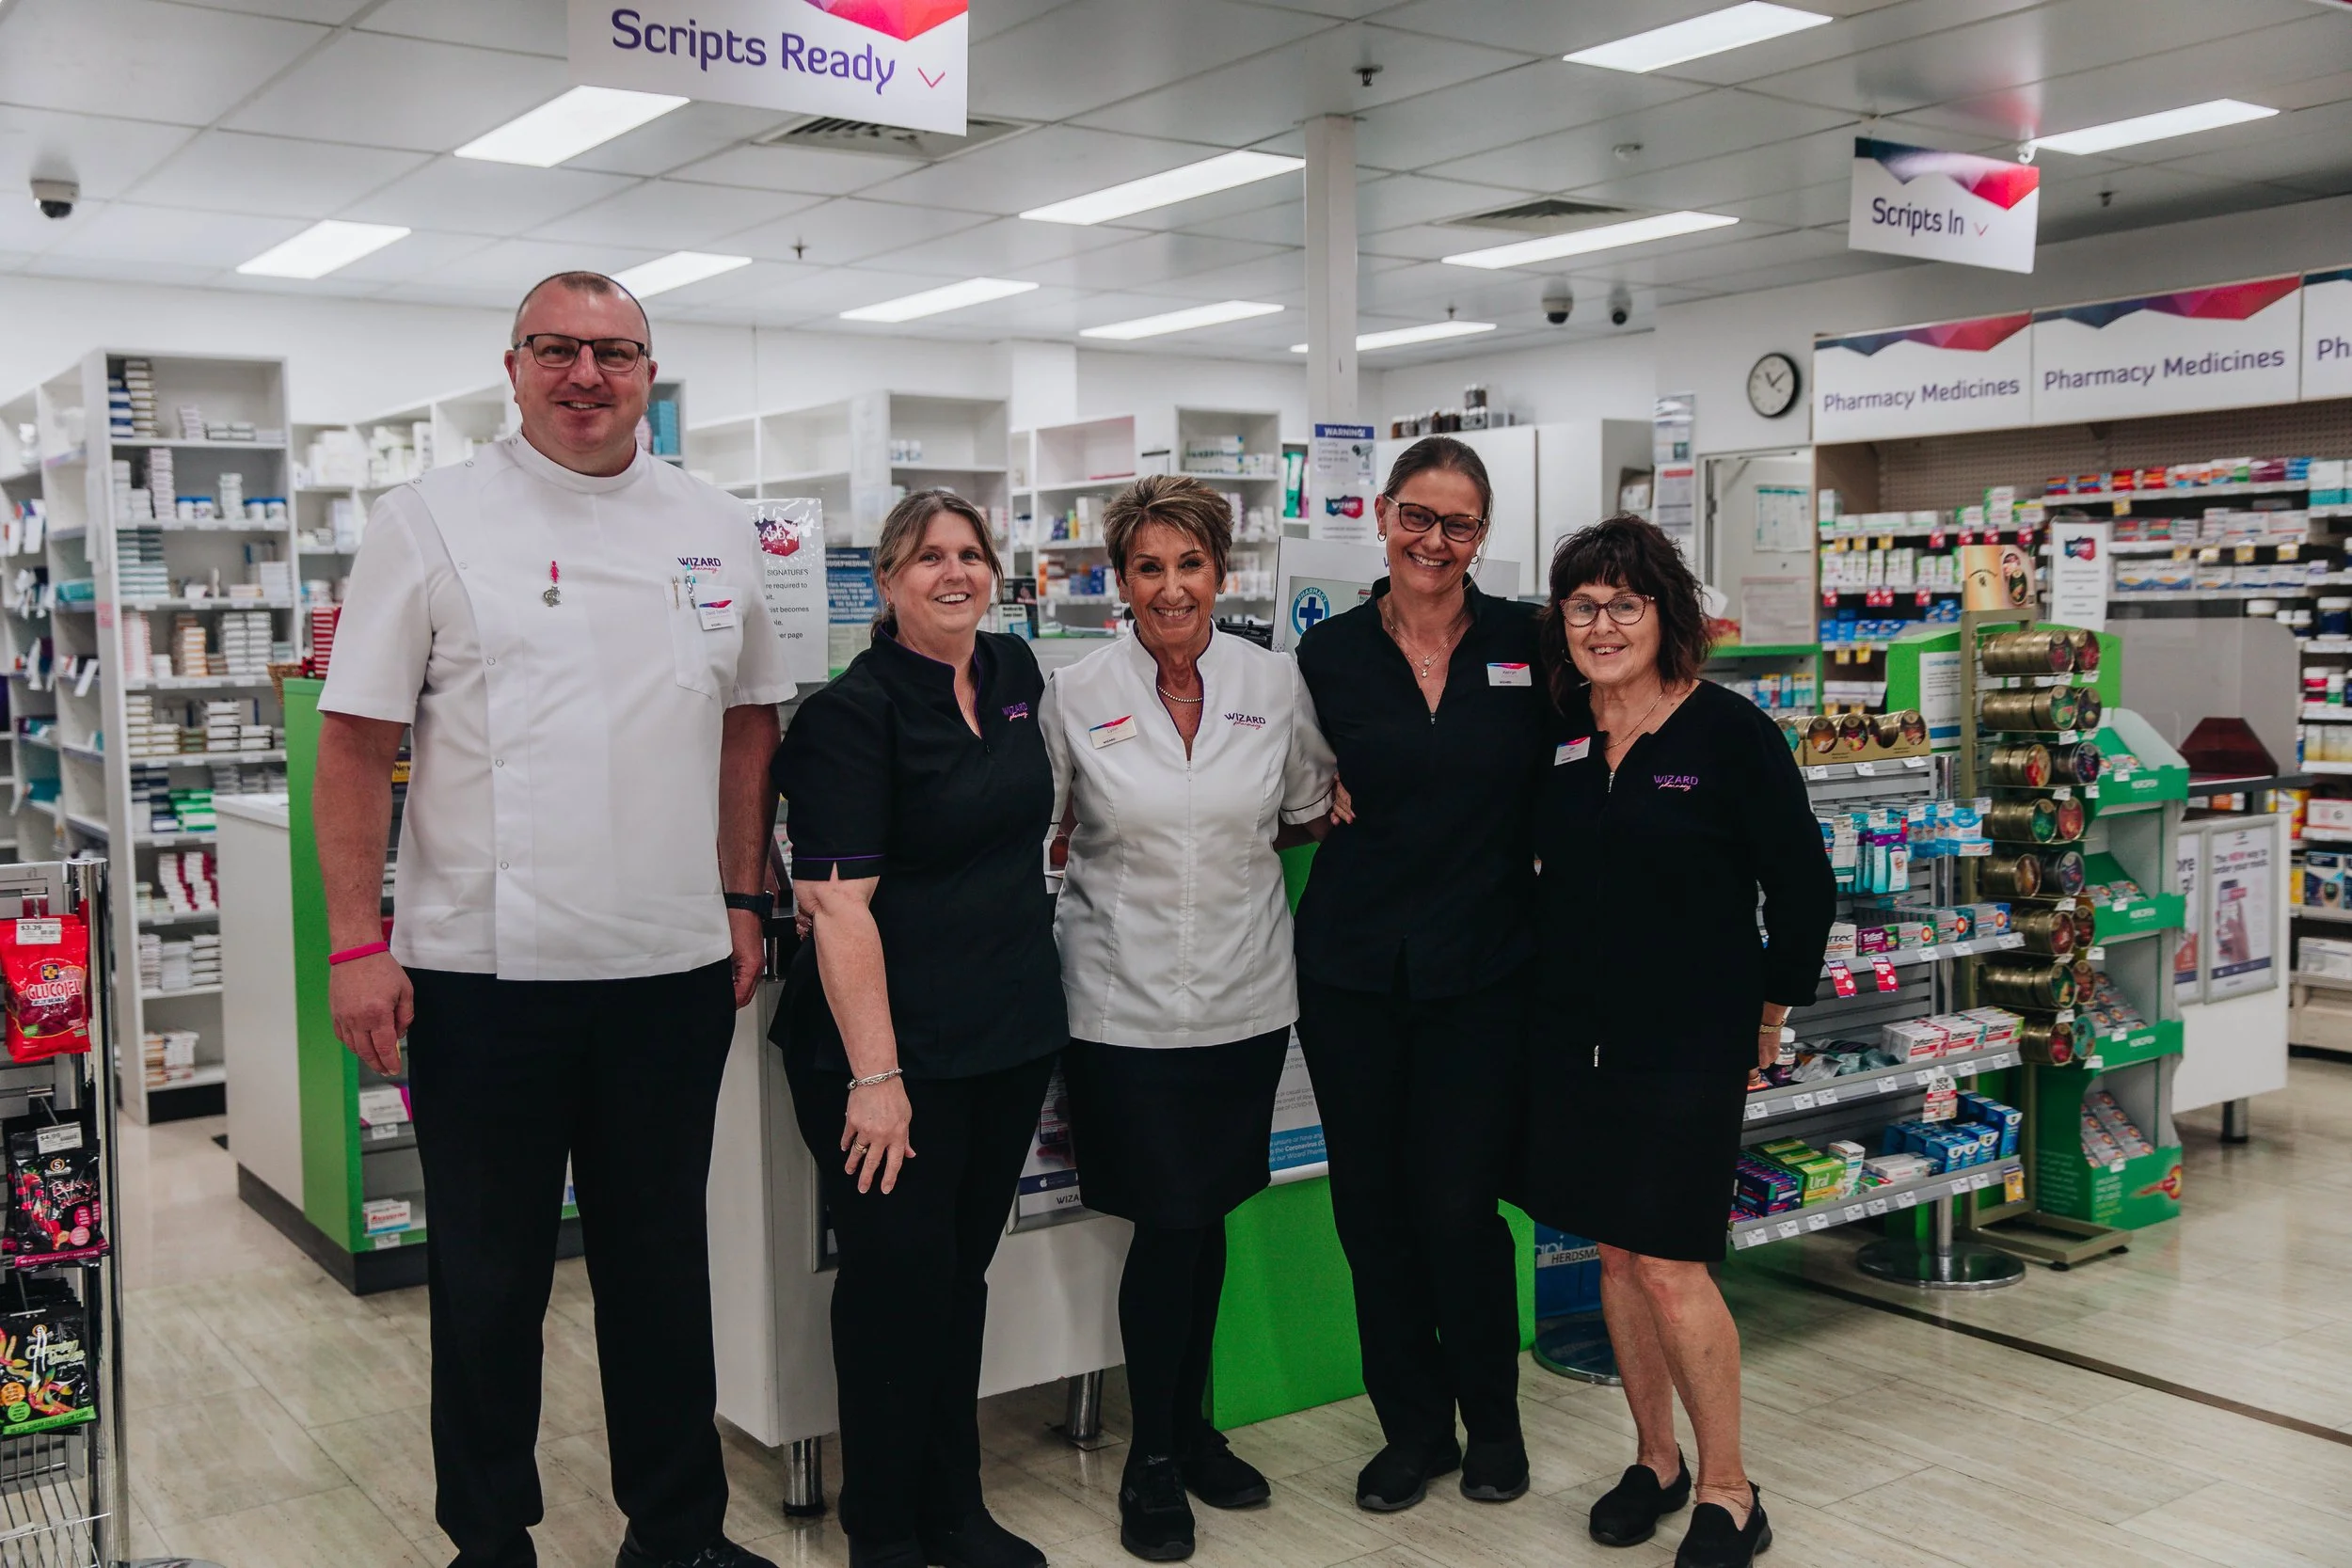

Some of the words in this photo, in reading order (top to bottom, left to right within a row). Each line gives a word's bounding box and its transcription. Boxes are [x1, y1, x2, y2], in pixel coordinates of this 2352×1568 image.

[612, 8, 767, 71] Scripts
[781, 32, 896, 94] Ready
[1872, 198, 1942, 236] Scripts
[1947, 207, 1964, 236] In
[2045, 361, 2155, 390] Pharmacy
[2164, 349, 2285, 377] Medicines
[1824, 388, 1915, 412] Pharmacy
[1921, 377, 2020, 403] Medicines
[1324, 426, 1366, 437] WARNING!
[677, 557, 722, 566] WIZARD
[773, 582, 800, 591] required
[1297, 587, 1328, 603] PHARMACY
[1002, 702, 1028, 715] WIZARD
[1224, 713, 1266, 724] WIZARD
[1653, 774, 1699, 785] WIZARD
[27, 981, 82, 1000] GLUCOJEL
[1285, 1142, 1317, 1152] Coronavirus
[1809, 1172, 1830, 1190] Ural
[1057, 1195, 1080, 1205] WIZA
[1552, 1246, 1599, 1264] HERDSMA
